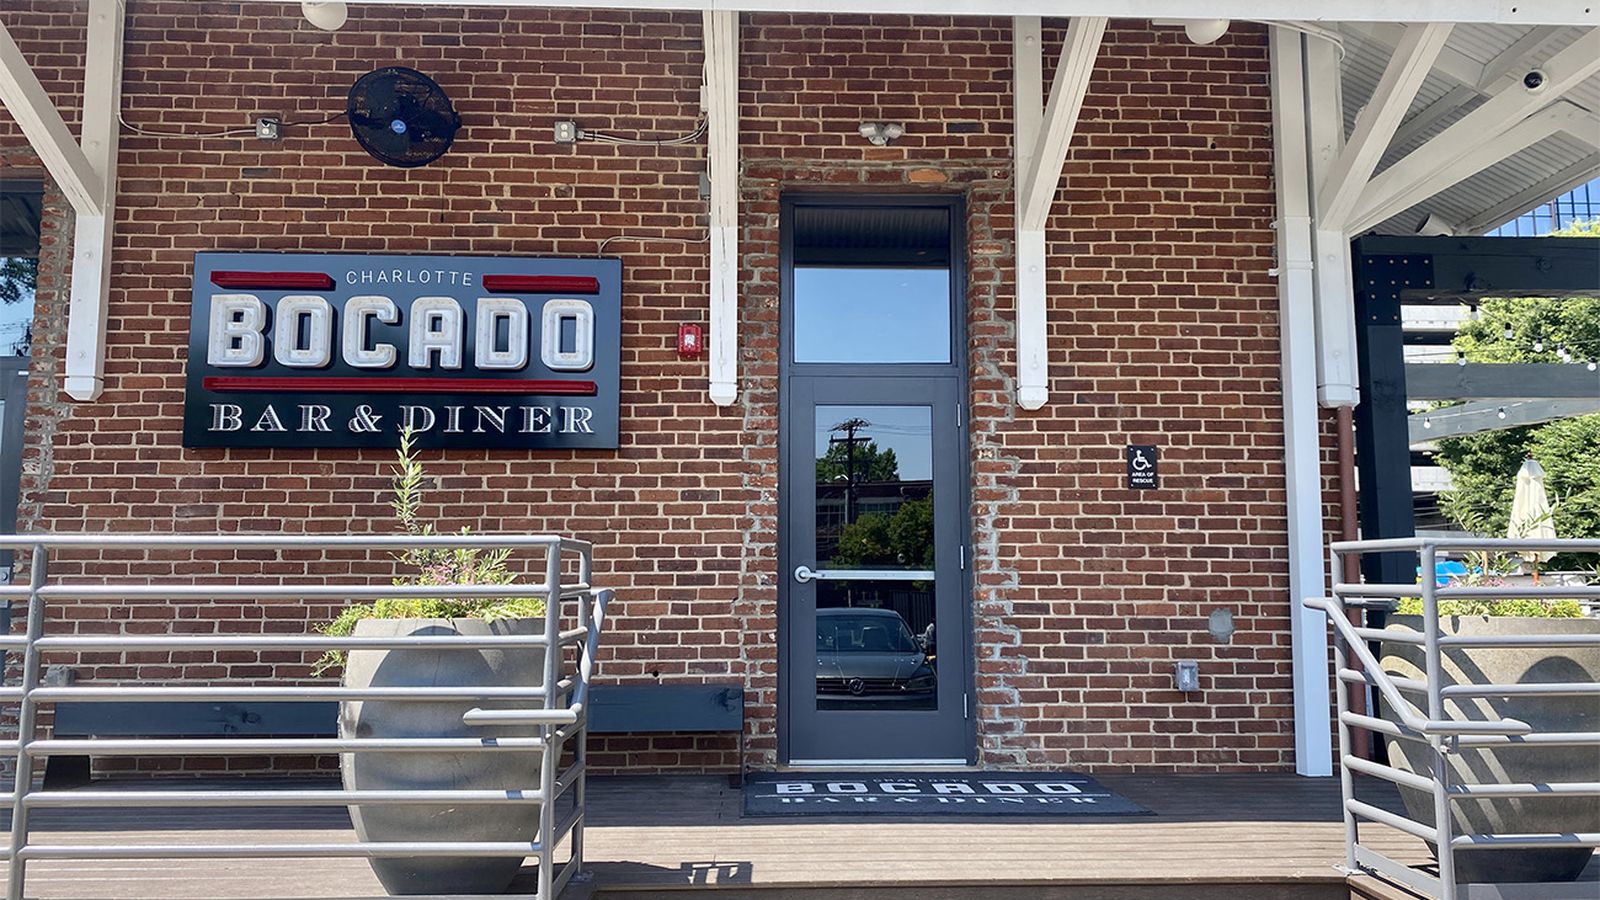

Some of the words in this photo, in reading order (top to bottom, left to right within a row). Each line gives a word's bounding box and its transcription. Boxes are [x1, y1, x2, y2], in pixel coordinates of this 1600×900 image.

[346, 270, 473, 286] CHARLOTTE
[207, 294, 595, 370] BOCADO
[208, 404, 332, 432] BAR
[348, 404, 383, 432] &
[397, 405, 594, 433] DINER
[776, 783, 1082, 794] BOCADO
